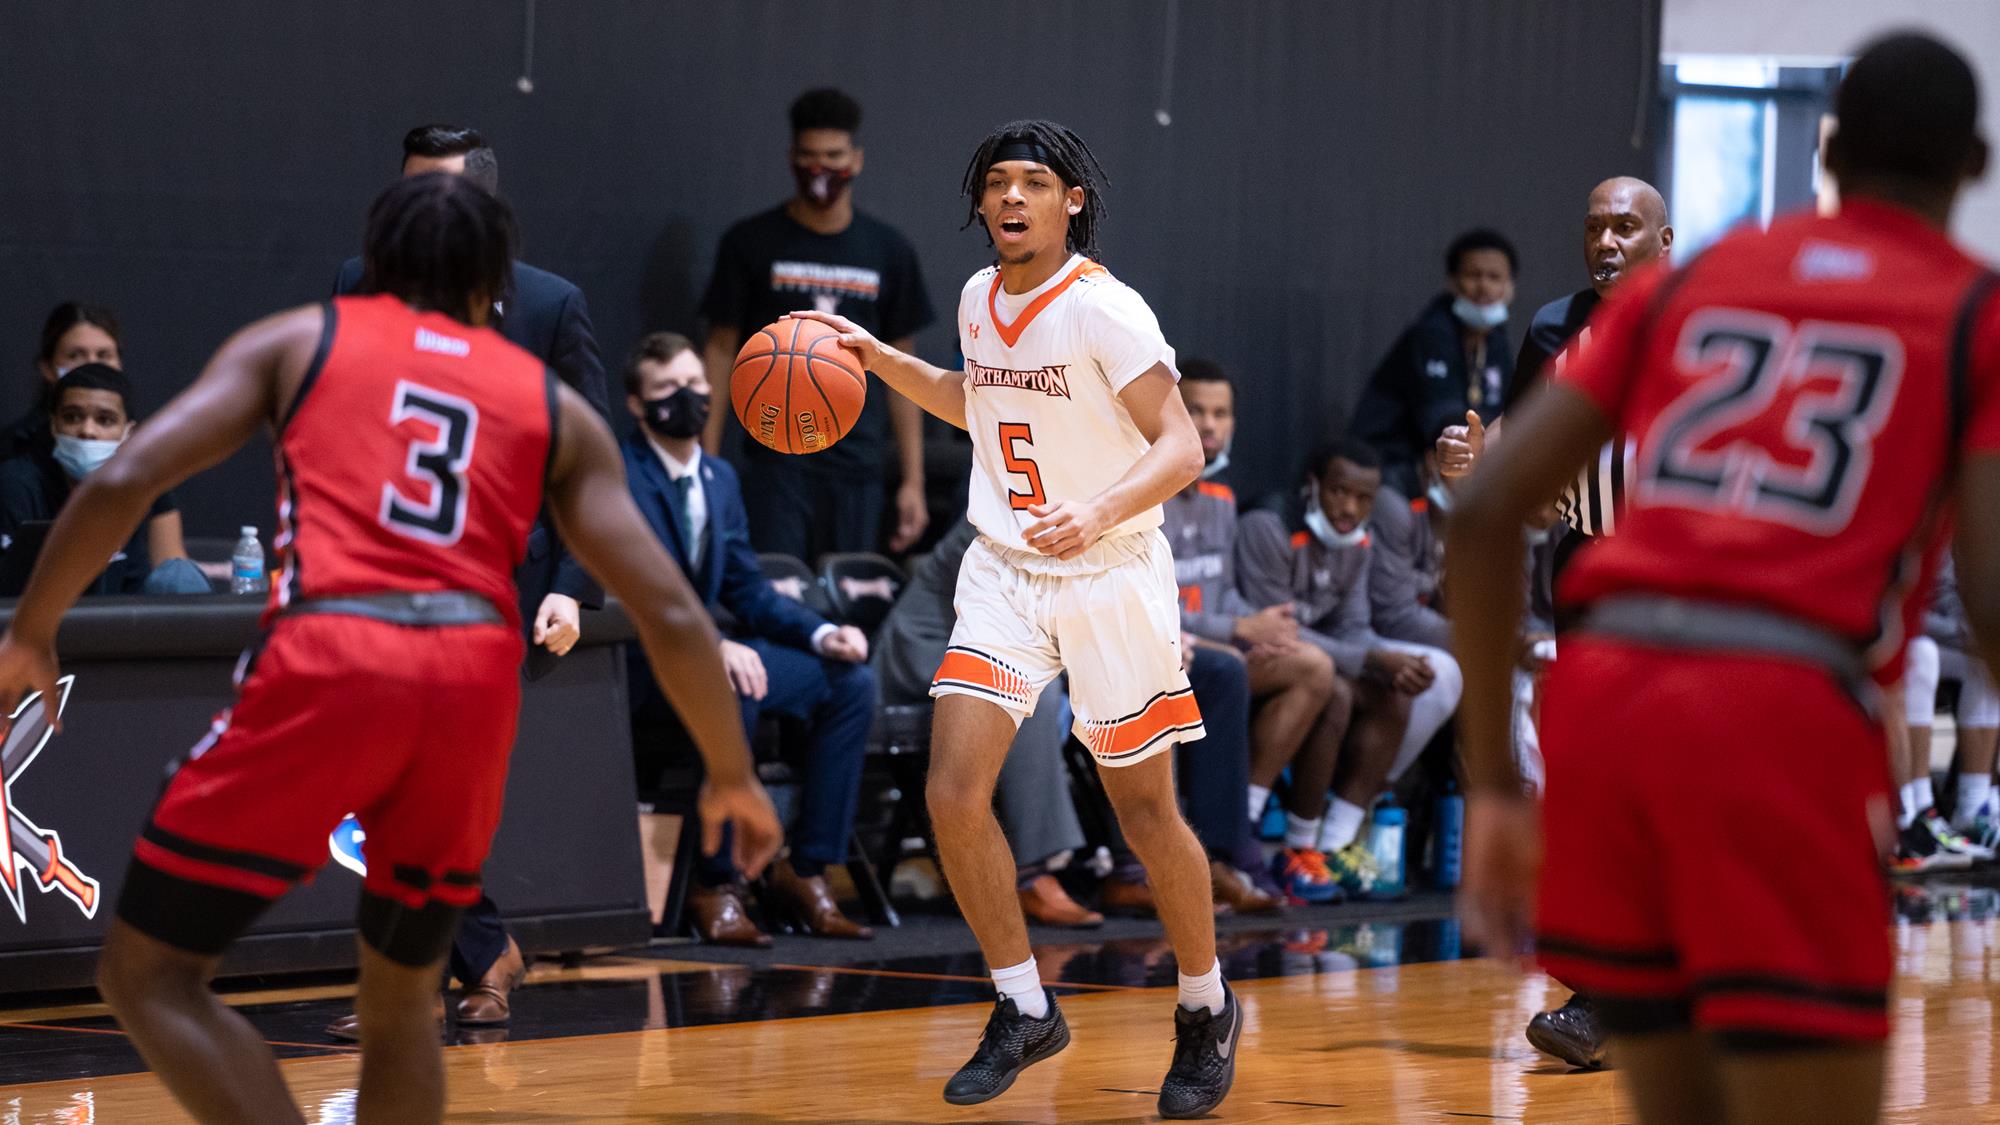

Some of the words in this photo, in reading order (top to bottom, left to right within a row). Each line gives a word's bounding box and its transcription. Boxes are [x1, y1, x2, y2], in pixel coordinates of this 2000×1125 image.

[966, 358, 1072, 400] NORTHAMPTON
[1635, 307, 1906, 537] 23
[380, 378, 480, 546] 3
[998, 421, 1046, 510] 5
